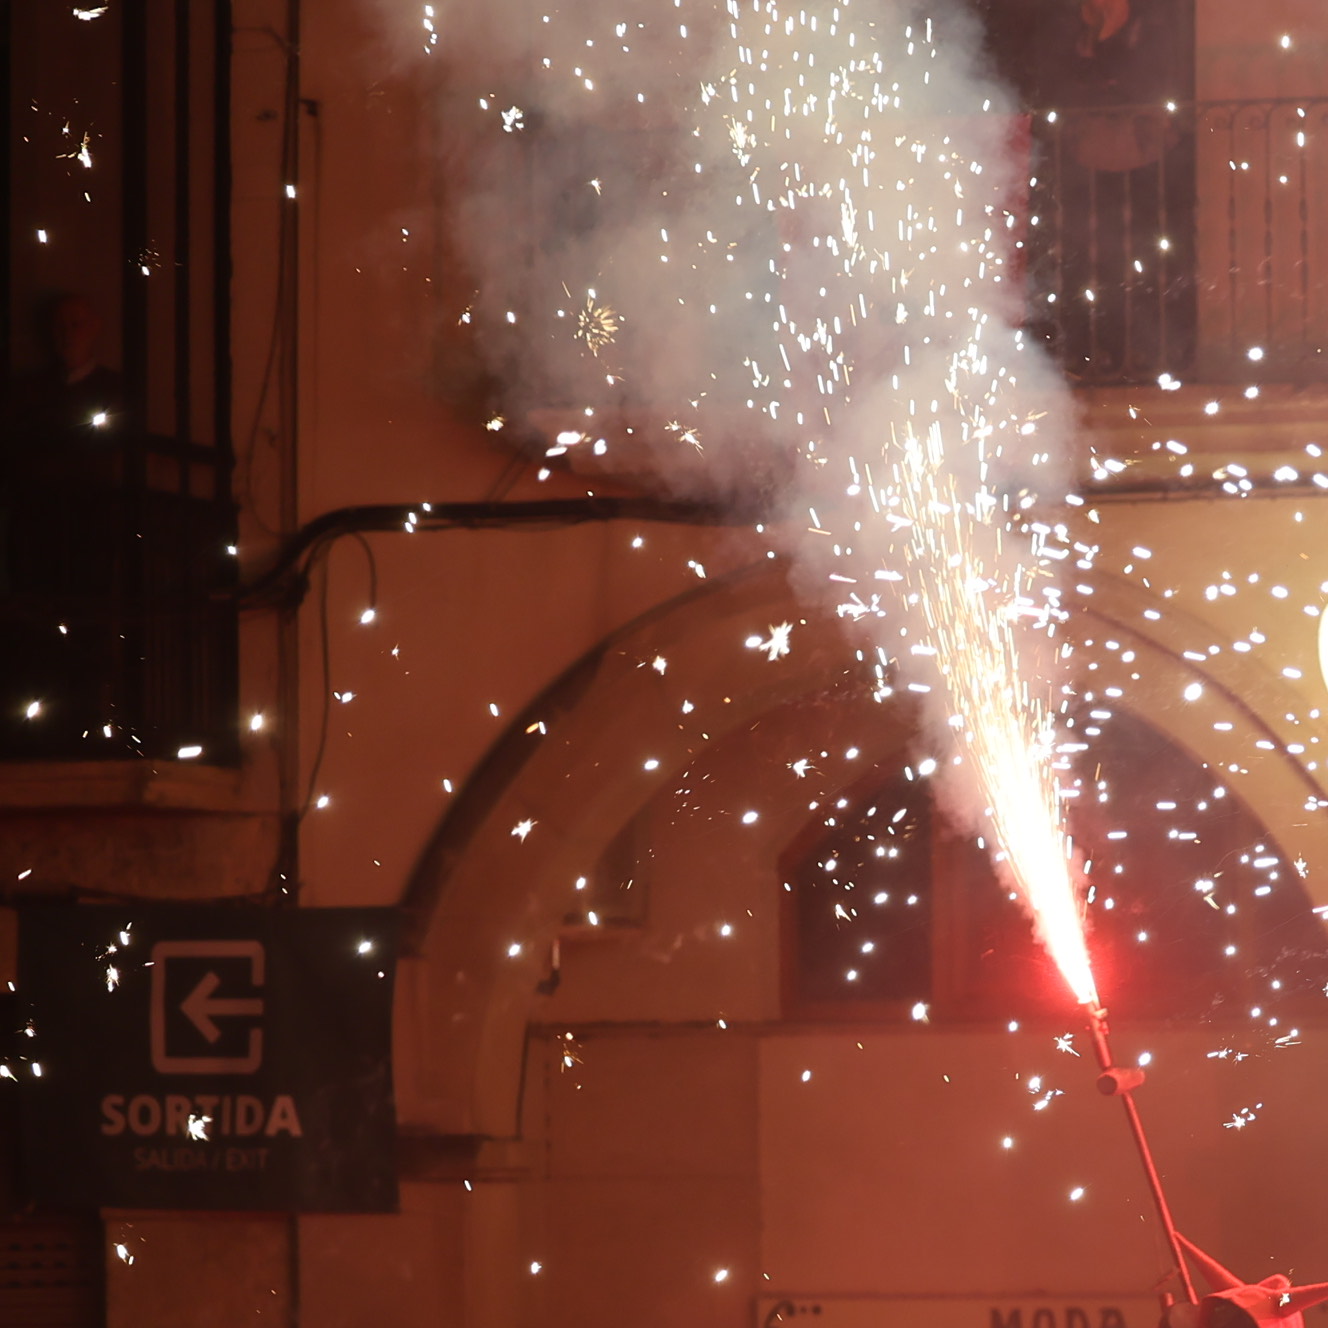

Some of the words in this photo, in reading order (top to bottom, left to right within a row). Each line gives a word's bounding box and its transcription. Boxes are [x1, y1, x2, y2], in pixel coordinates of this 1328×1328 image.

[101, 1094, 303, 1137] SORTIDA
[134, 1148, 207, 1172] SALIDA
[226, 1148, 269, 1172] EXIT
